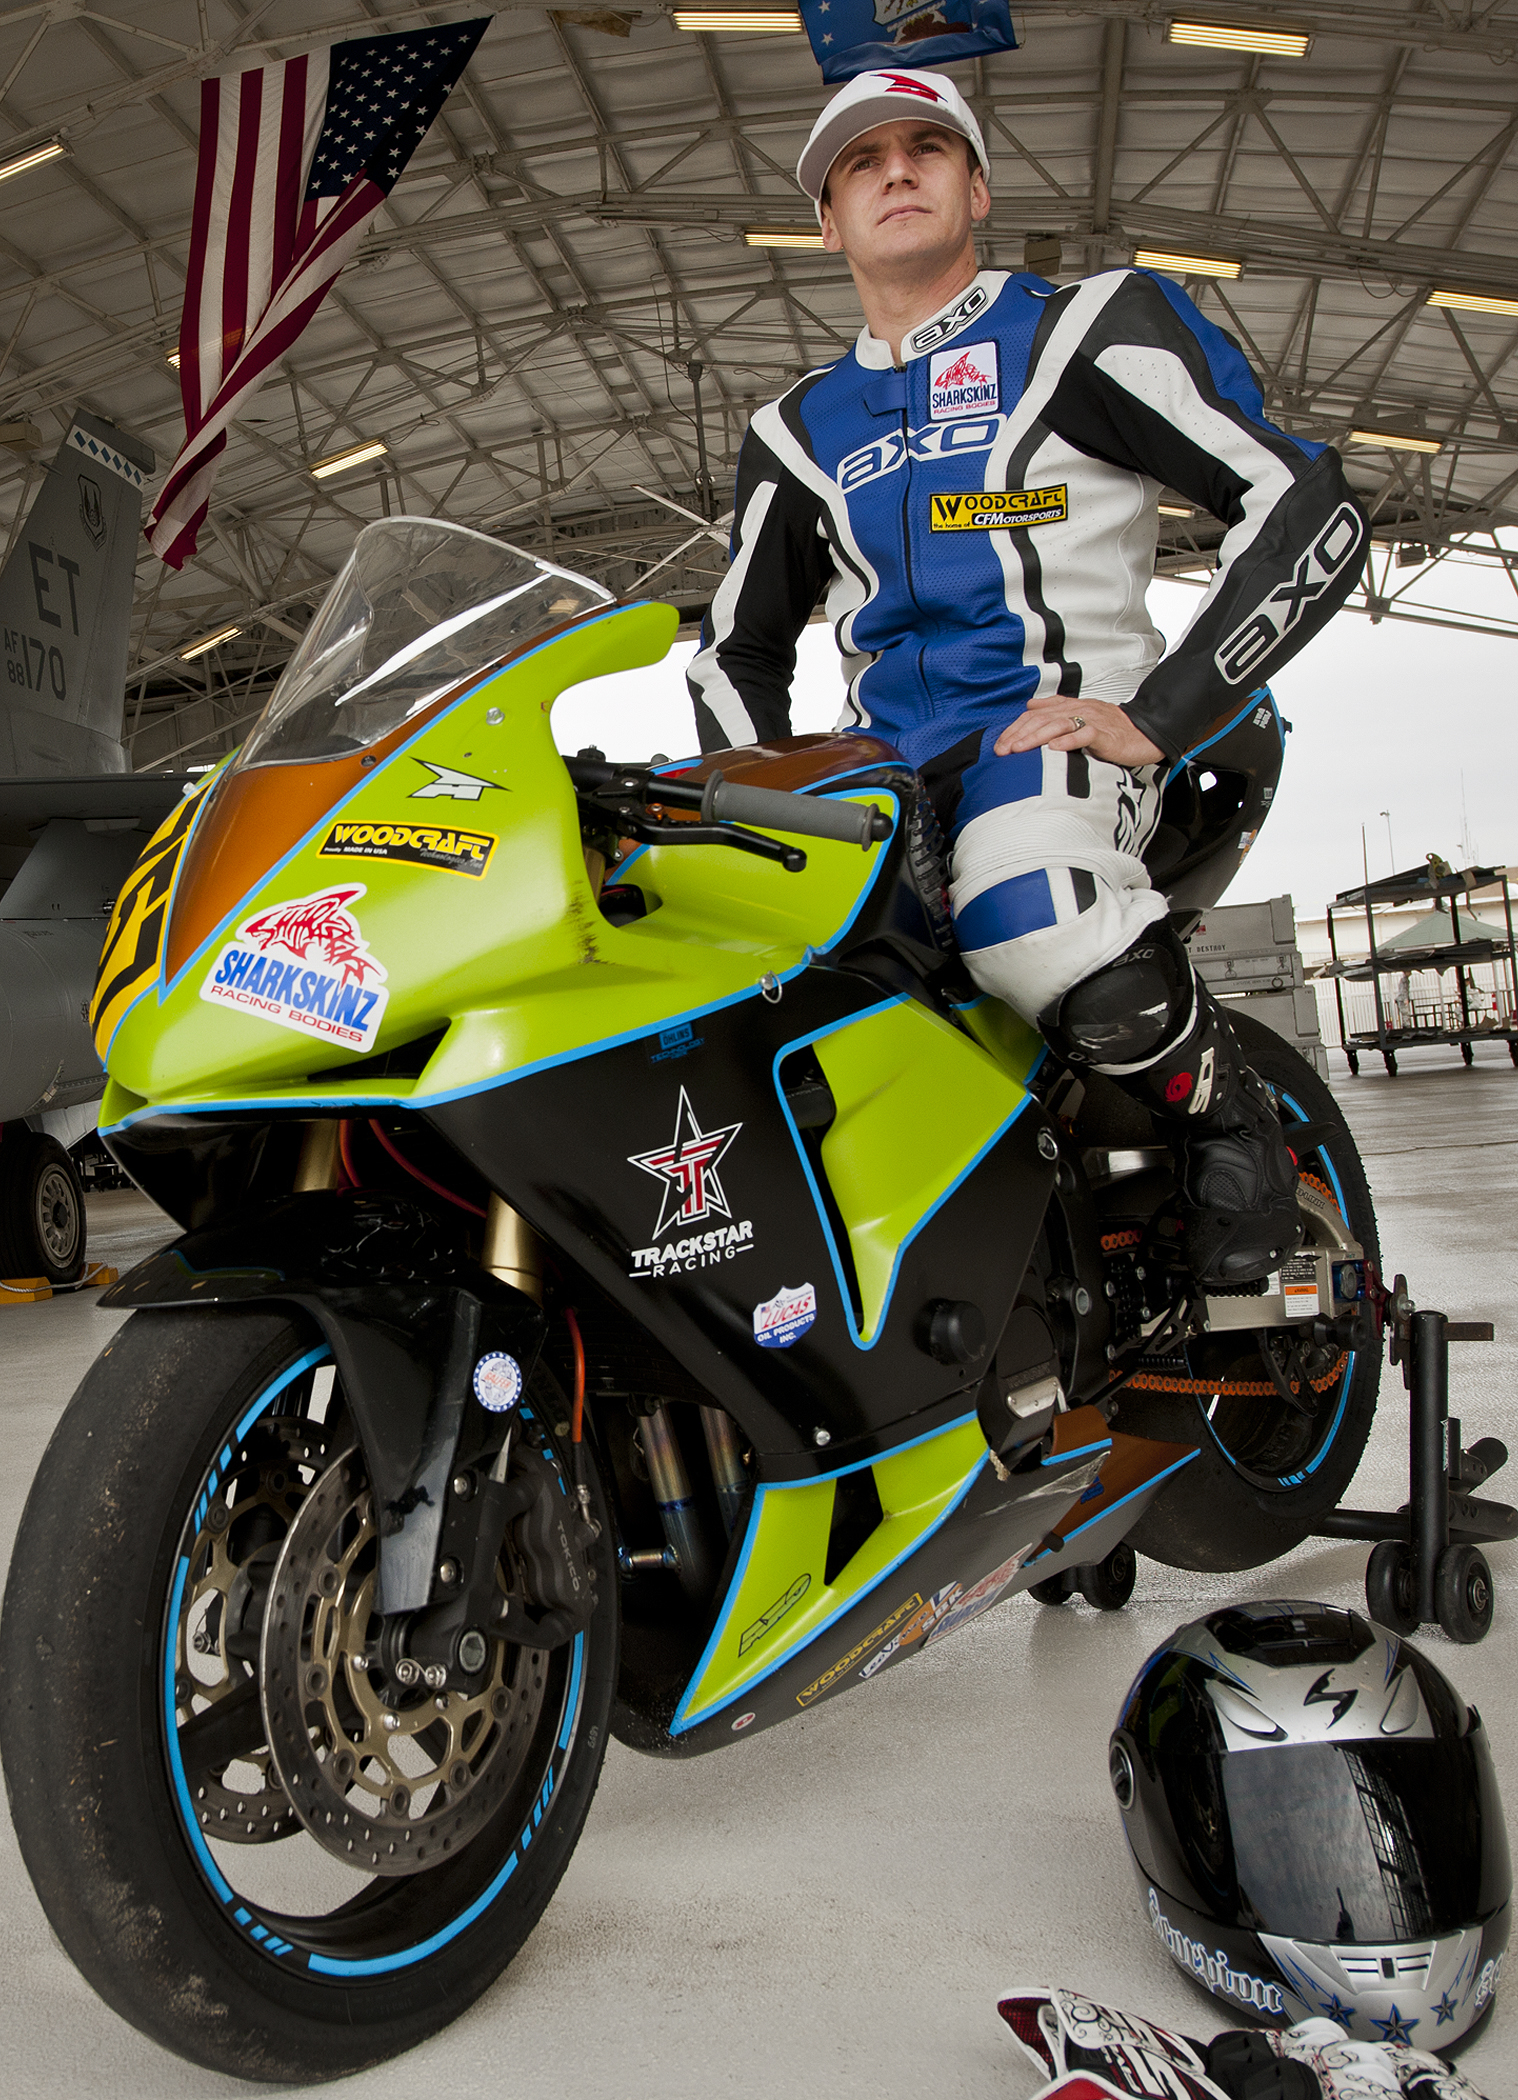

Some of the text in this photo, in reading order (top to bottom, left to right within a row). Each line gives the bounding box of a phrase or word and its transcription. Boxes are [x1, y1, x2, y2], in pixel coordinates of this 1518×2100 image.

[932, 384, 997, 408] SHARKSKINZ
[934, 400, 996, 415] RACING BODIES
[934, 487, 1063, 522] WOODCRAFT
[28, 541, 80, 637] ET
[4, 628, 19, 653] AF
[7, 634, 67, 701] 88 170
[335, 825, 490, 861] WOODCRAFT
[343, 846, 363, 854] MADE
[373, 847, 388, 856] USA
[1196, 944, 1227, 953] DESTROY
[215, 950, 379, 1032] SHARKSKINZ
[211, 985, 363, 1043] RACING BODIES
[631, 1220, 753, 1267] TRACKSTAR
[653, 1246, 735, 1278] RACING
[757, 1313, 815, 1342] OIL PRODUCTS
[762, 1296, 811, 1329] LUCAS
[779, 1332, 796, 1343] INC.
[557, 1520, 581, 1591] TOKICO
[802, 1598, 916, 1697] WOODCRAFT
[1149, 1887, 1283, 2013] Scorpion
